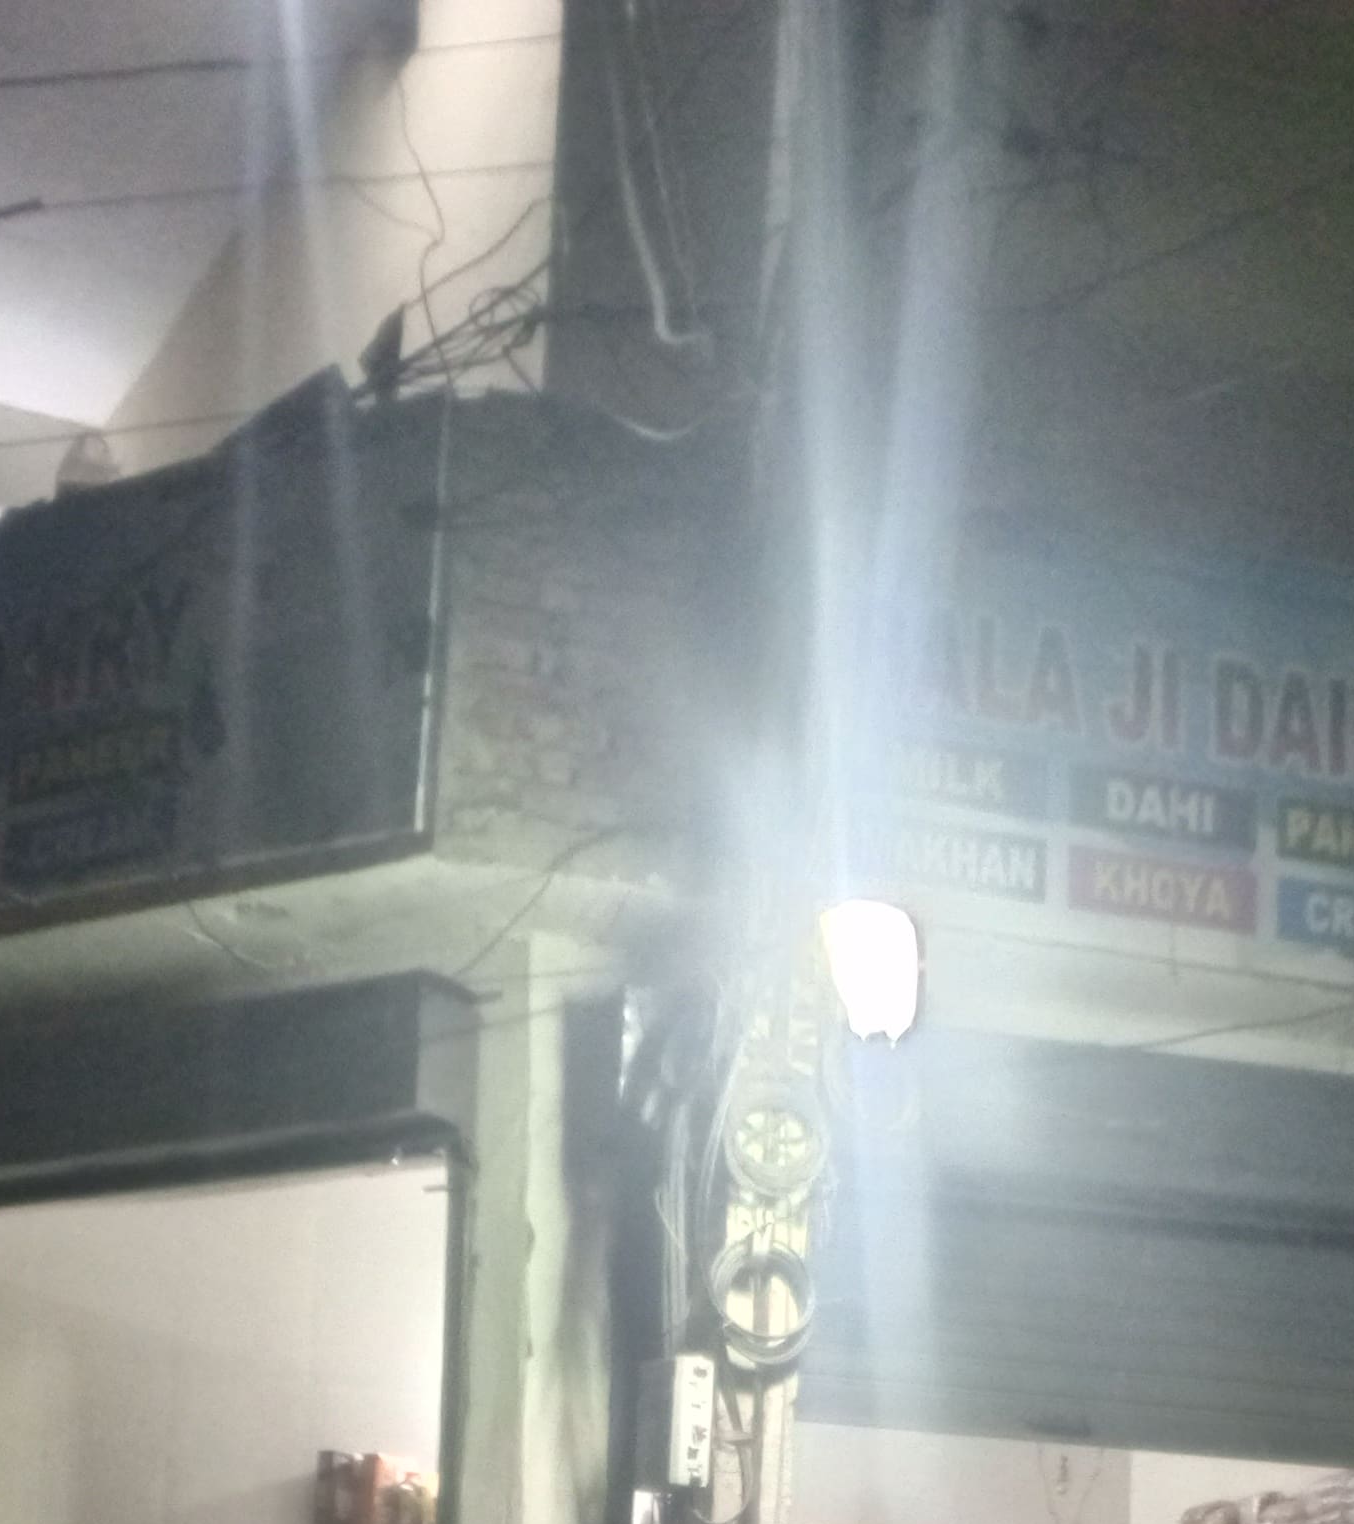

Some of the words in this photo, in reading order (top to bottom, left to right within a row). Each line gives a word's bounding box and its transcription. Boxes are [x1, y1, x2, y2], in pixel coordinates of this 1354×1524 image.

[1107, 639, 1183, 752] JI
[1104, 780, 1216, 833] DAHI
[1092, 860, 1233, 922] KHOYA
